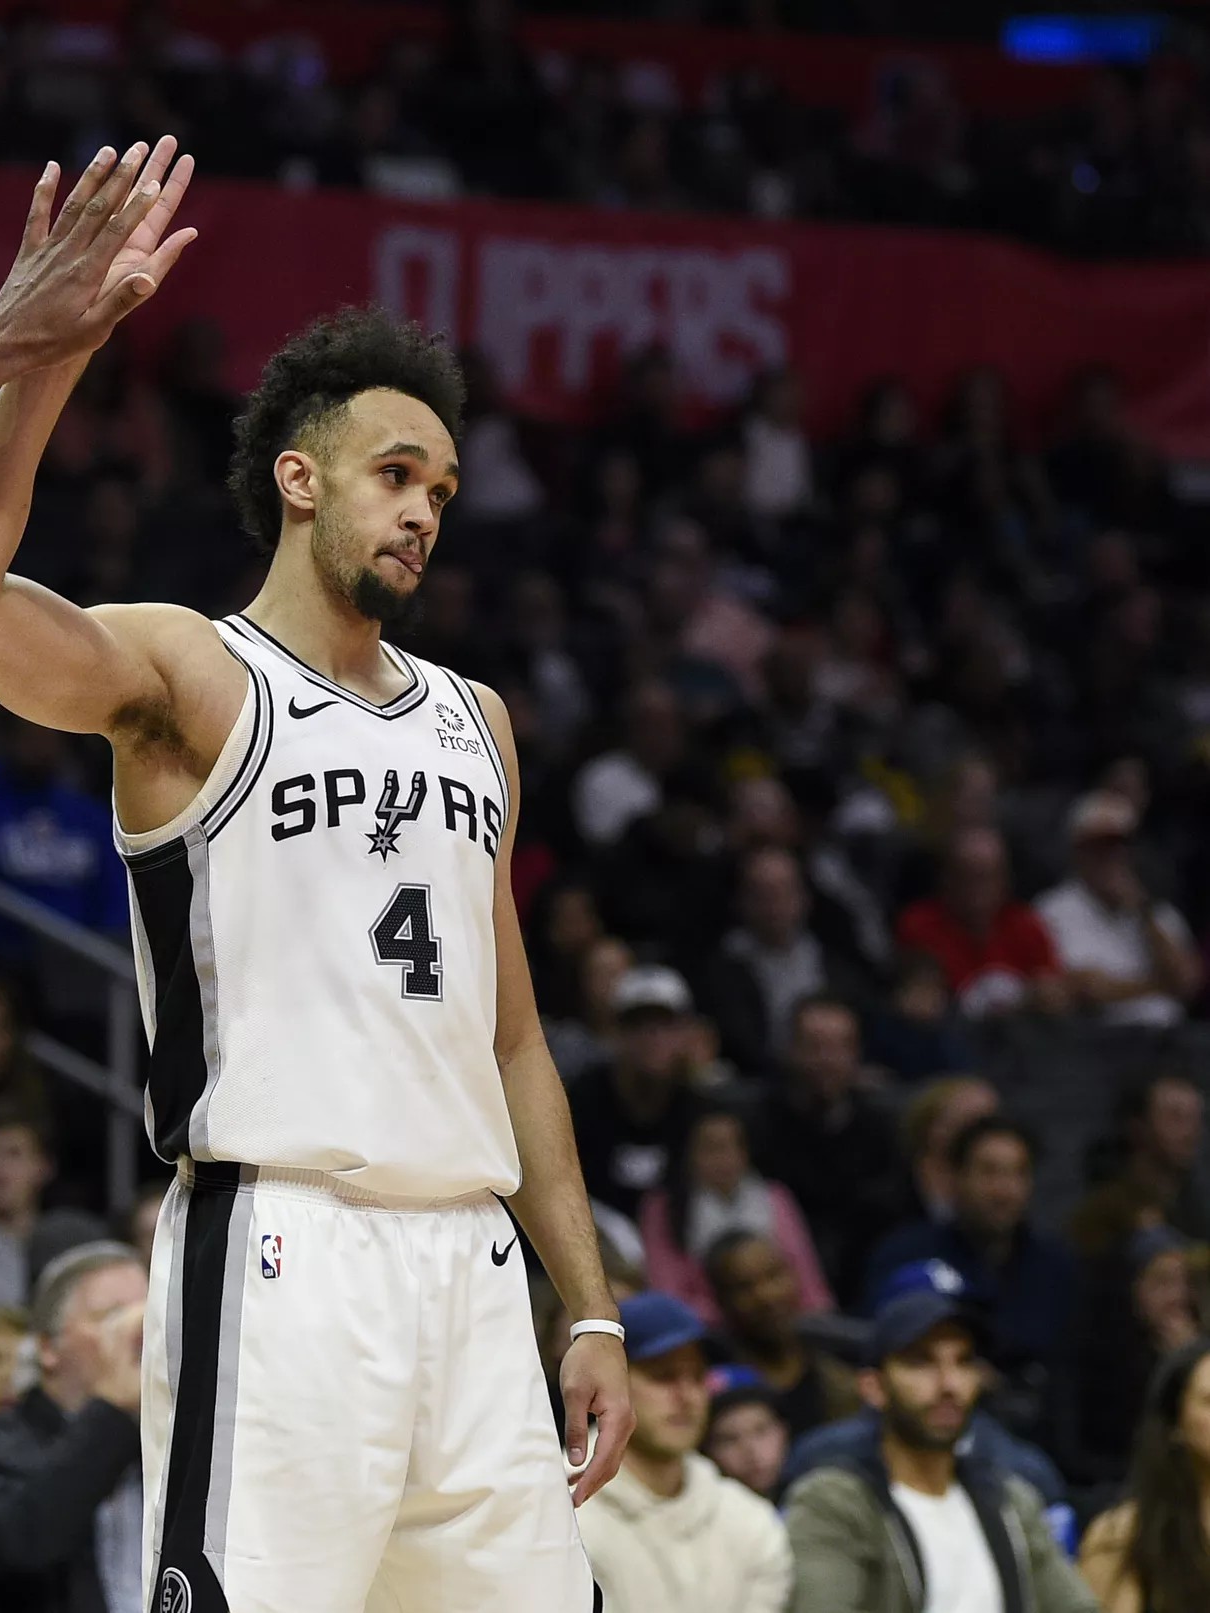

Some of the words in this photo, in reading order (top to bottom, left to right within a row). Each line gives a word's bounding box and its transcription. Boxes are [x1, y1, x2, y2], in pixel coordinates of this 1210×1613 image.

[436, 728, 485, 758] Frost
[271, 768, 502, 863] SPURS
[367, 883, 443, 1002] 4
